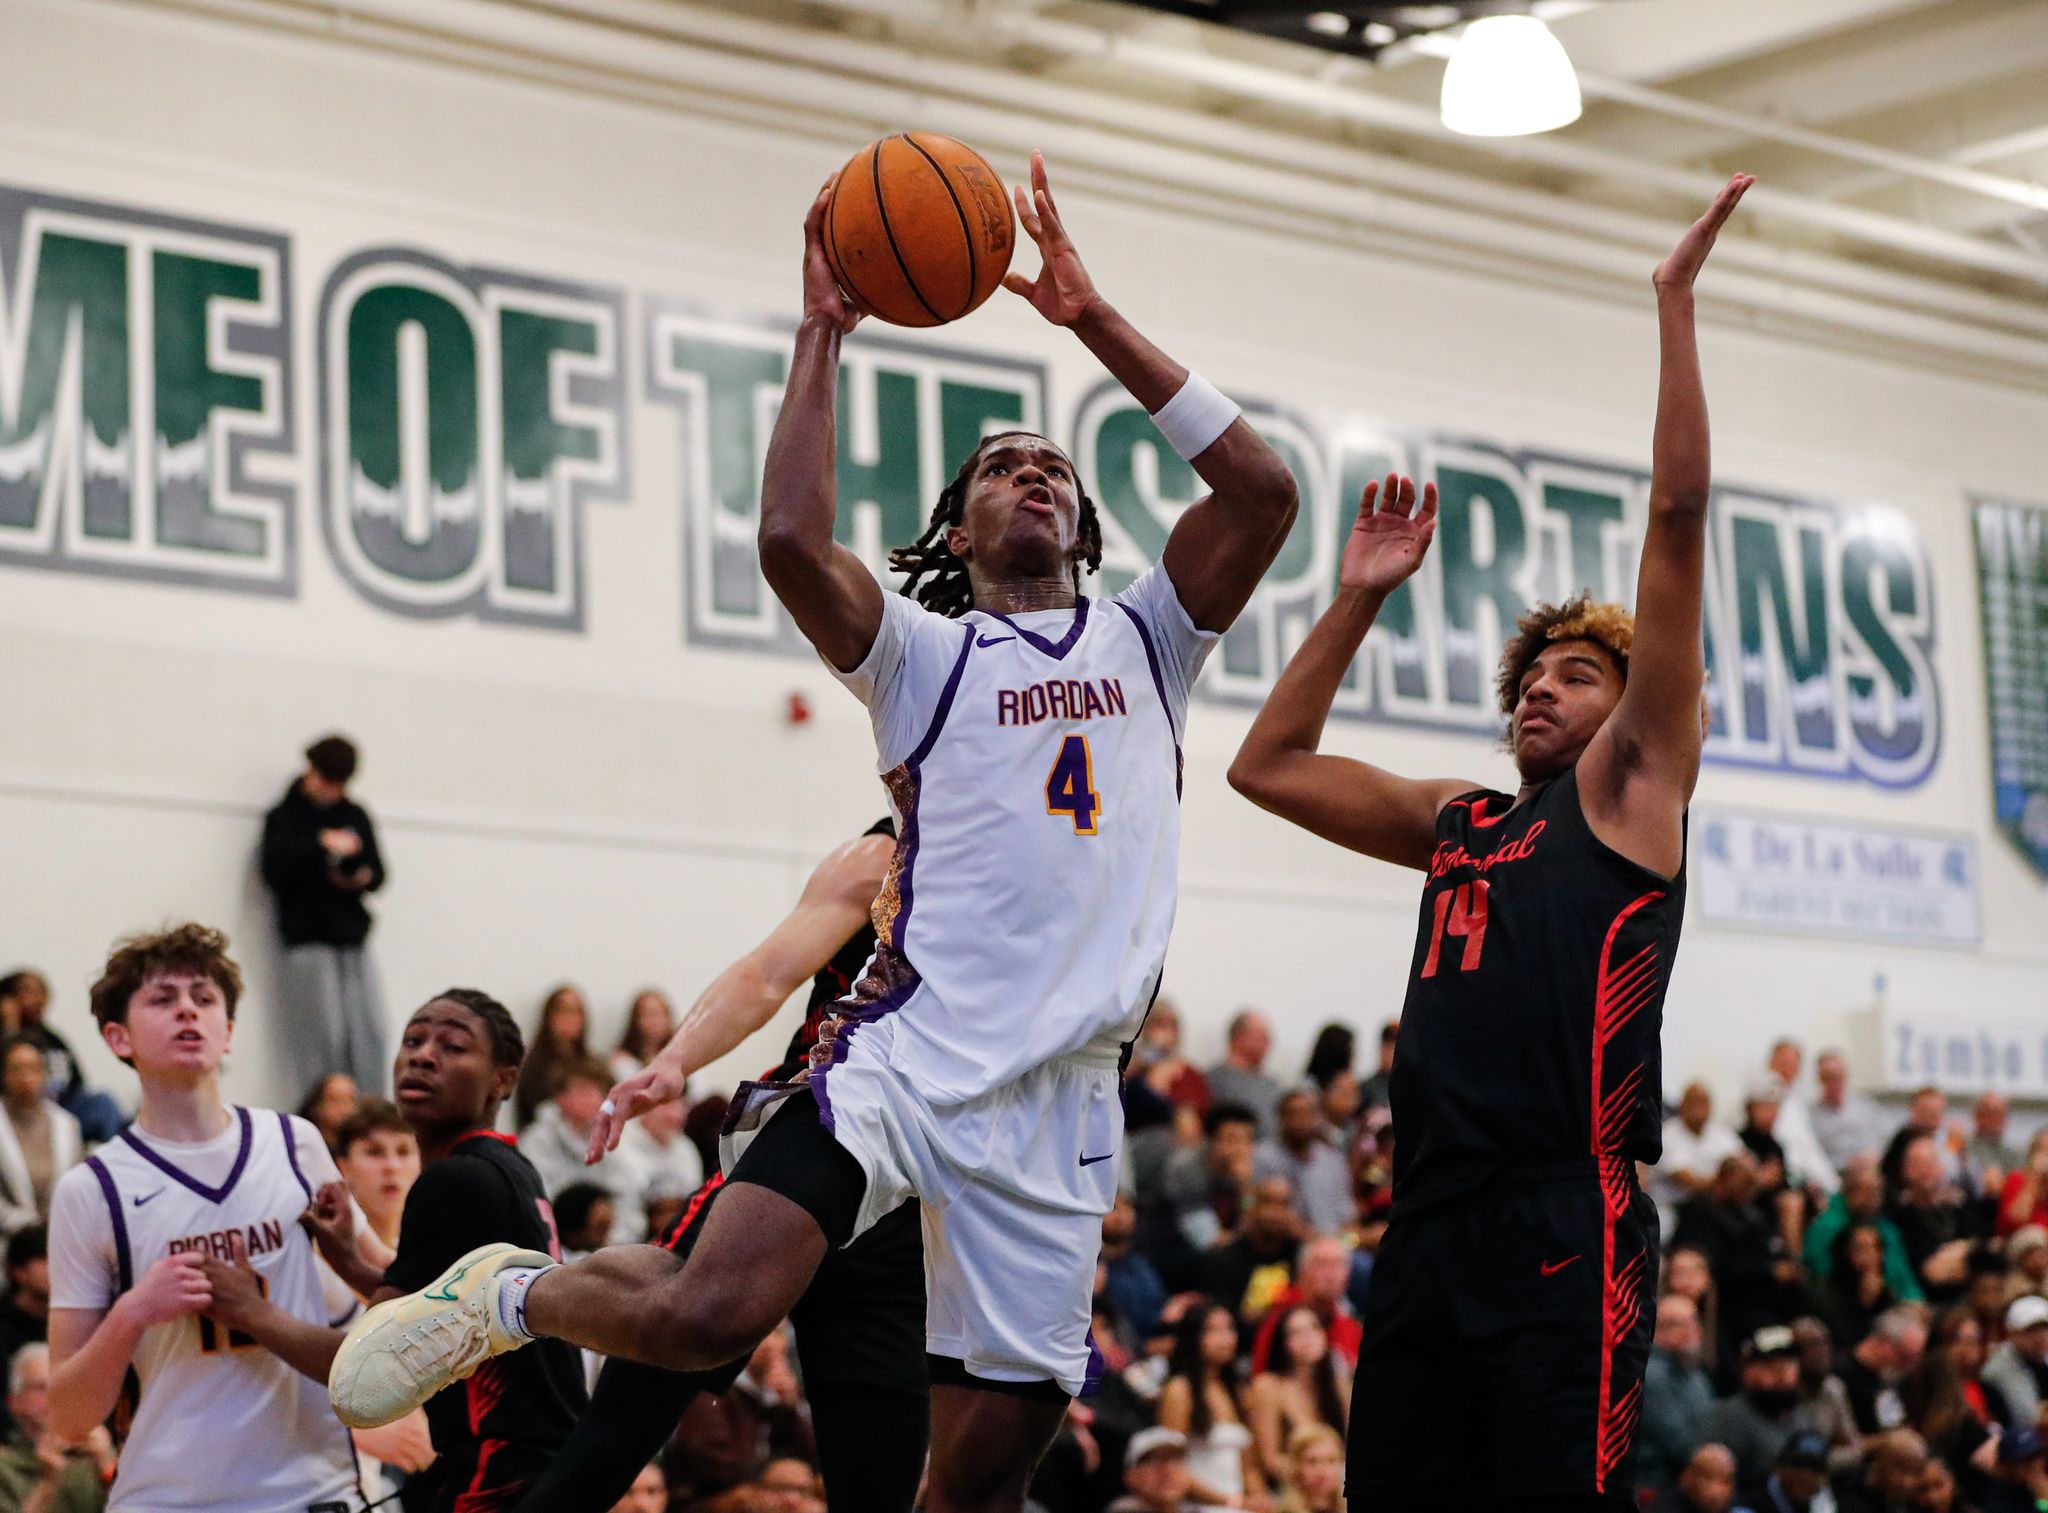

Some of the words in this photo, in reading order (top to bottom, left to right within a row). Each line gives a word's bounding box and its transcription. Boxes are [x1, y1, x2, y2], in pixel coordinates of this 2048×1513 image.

[326, 258, 616, 618] OF
[1073, 374, 1934, 784] SPARTNS
[997, 678, 1127, 727] RIORDAN
[1044, 733, 1102, 836] 4
[1420, 879, 1490, 979] 14
